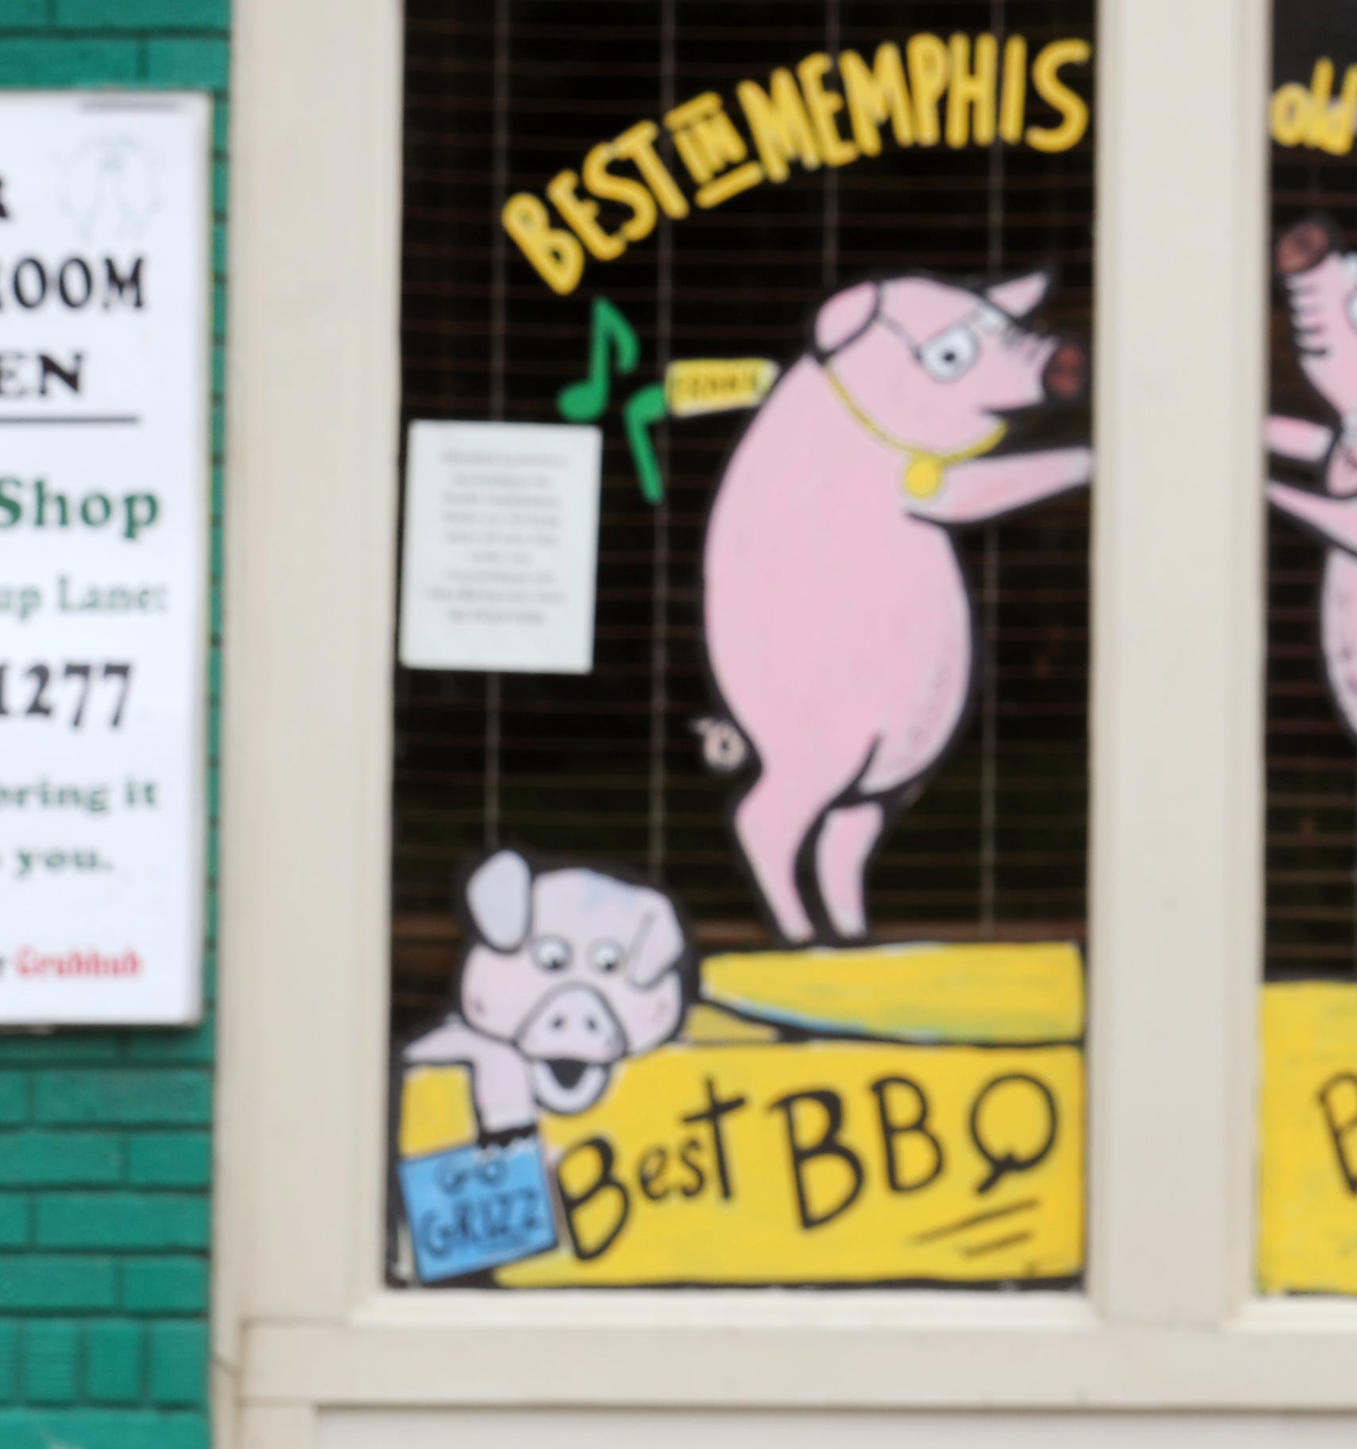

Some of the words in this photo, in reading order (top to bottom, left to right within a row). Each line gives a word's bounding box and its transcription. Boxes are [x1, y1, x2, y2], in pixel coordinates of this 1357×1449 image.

[502, 120, 690, 295] BEST
[663, 91, 764, 208] IN
[736, 32, 1092, 183] MEMPHIS
[0, 255, 144, 311] OOM
[556, 1073, 748, 1264] Best
[765, 1071, 1060, 1232] BBQ
